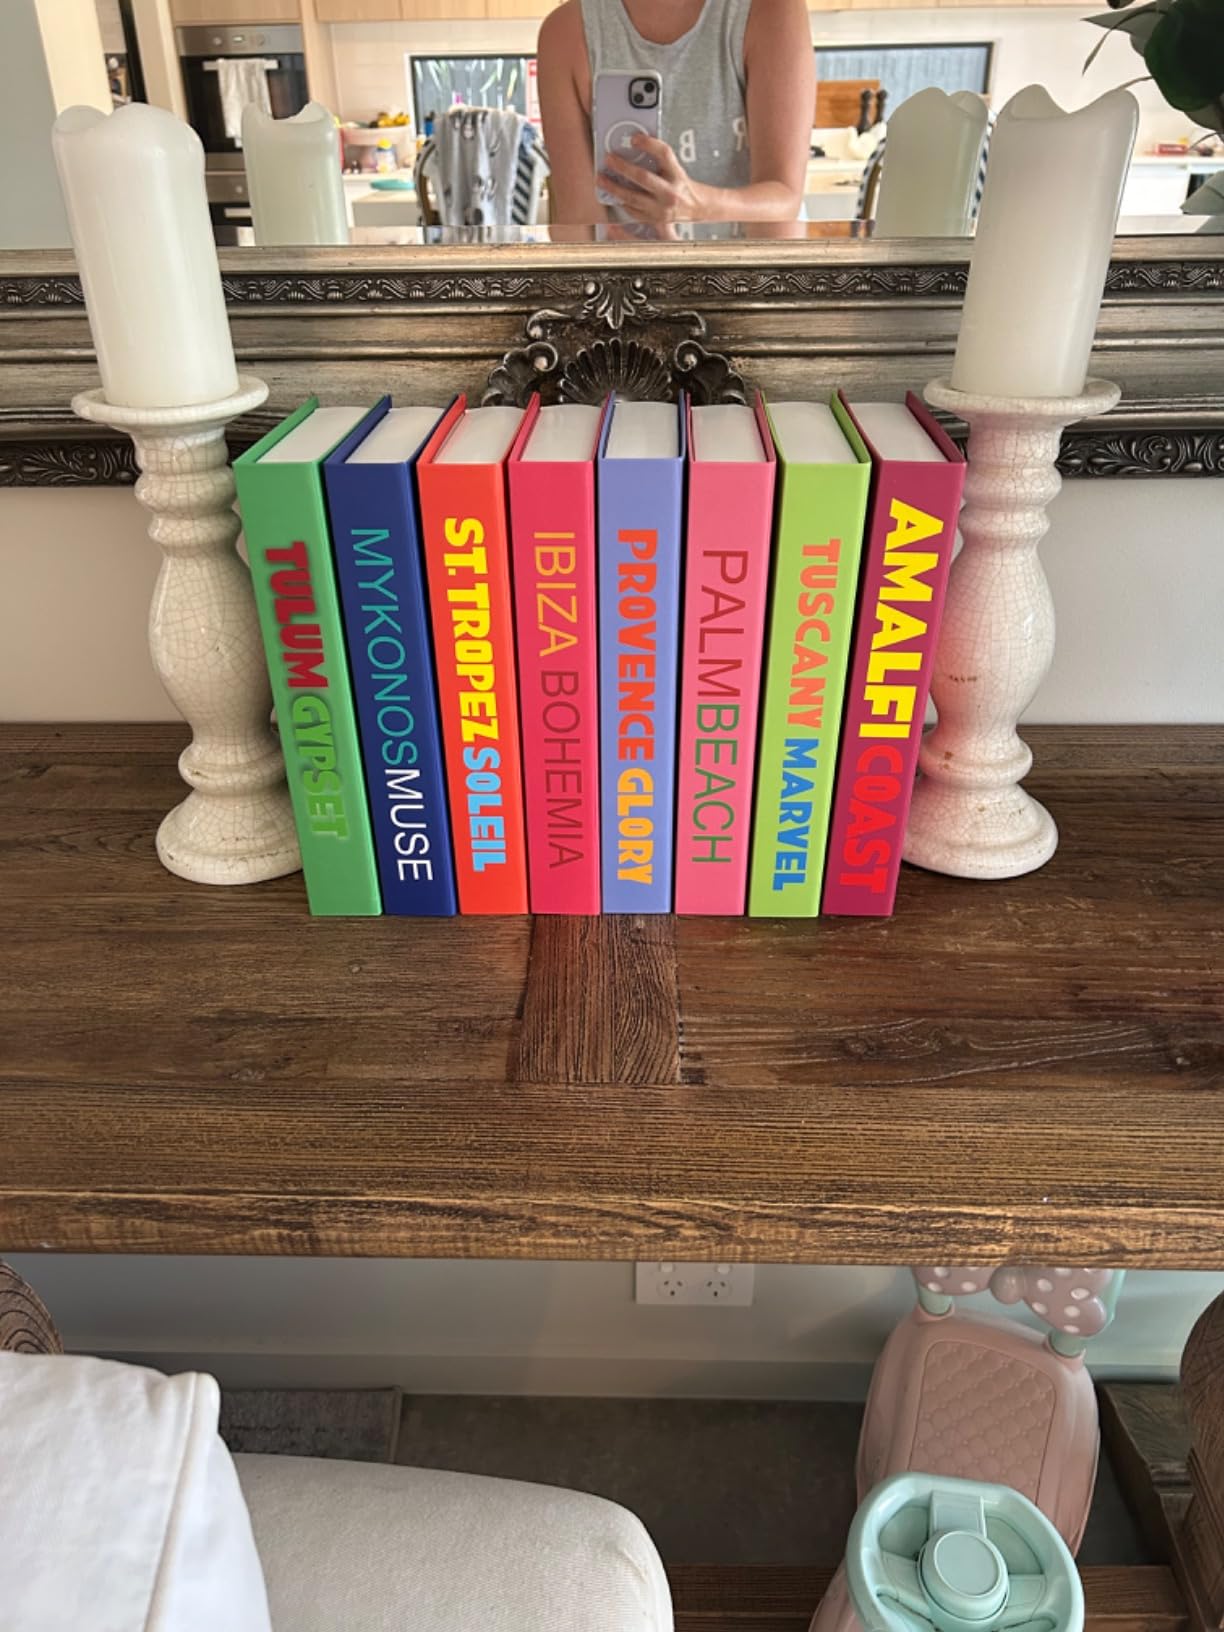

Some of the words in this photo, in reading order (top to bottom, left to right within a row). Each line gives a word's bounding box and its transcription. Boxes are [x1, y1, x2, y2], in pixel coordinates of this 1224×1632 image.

[265, 541, 329, 689] TULUM
[444, 518, 488, 576] ST.
[533, 531, 579, 657] IBIZA
[858, 498, 944, 738] AMALFI
[351, 529, 418, 766] MYKONOS
[447, 582, 499, 743] TROPEZ
[617, 528, 658, 761] PROVENCE
[697, 550, 748, 697] PALM
[786, 538, 841, 729] TUSCANY
[292, 695, 350, 840] GYPSET
[384, 769, 433, 881] MUSE
[463, 746, 506, 872] SOLEIL
[541, 669, 584, 869] BOHEMIA
[617, 768, 654, 885] GLORY
[691, 704, 740, 863] BEACH
[772, 738, 819, 891] MARVEL
[839, 744, 903, 894] COAST
